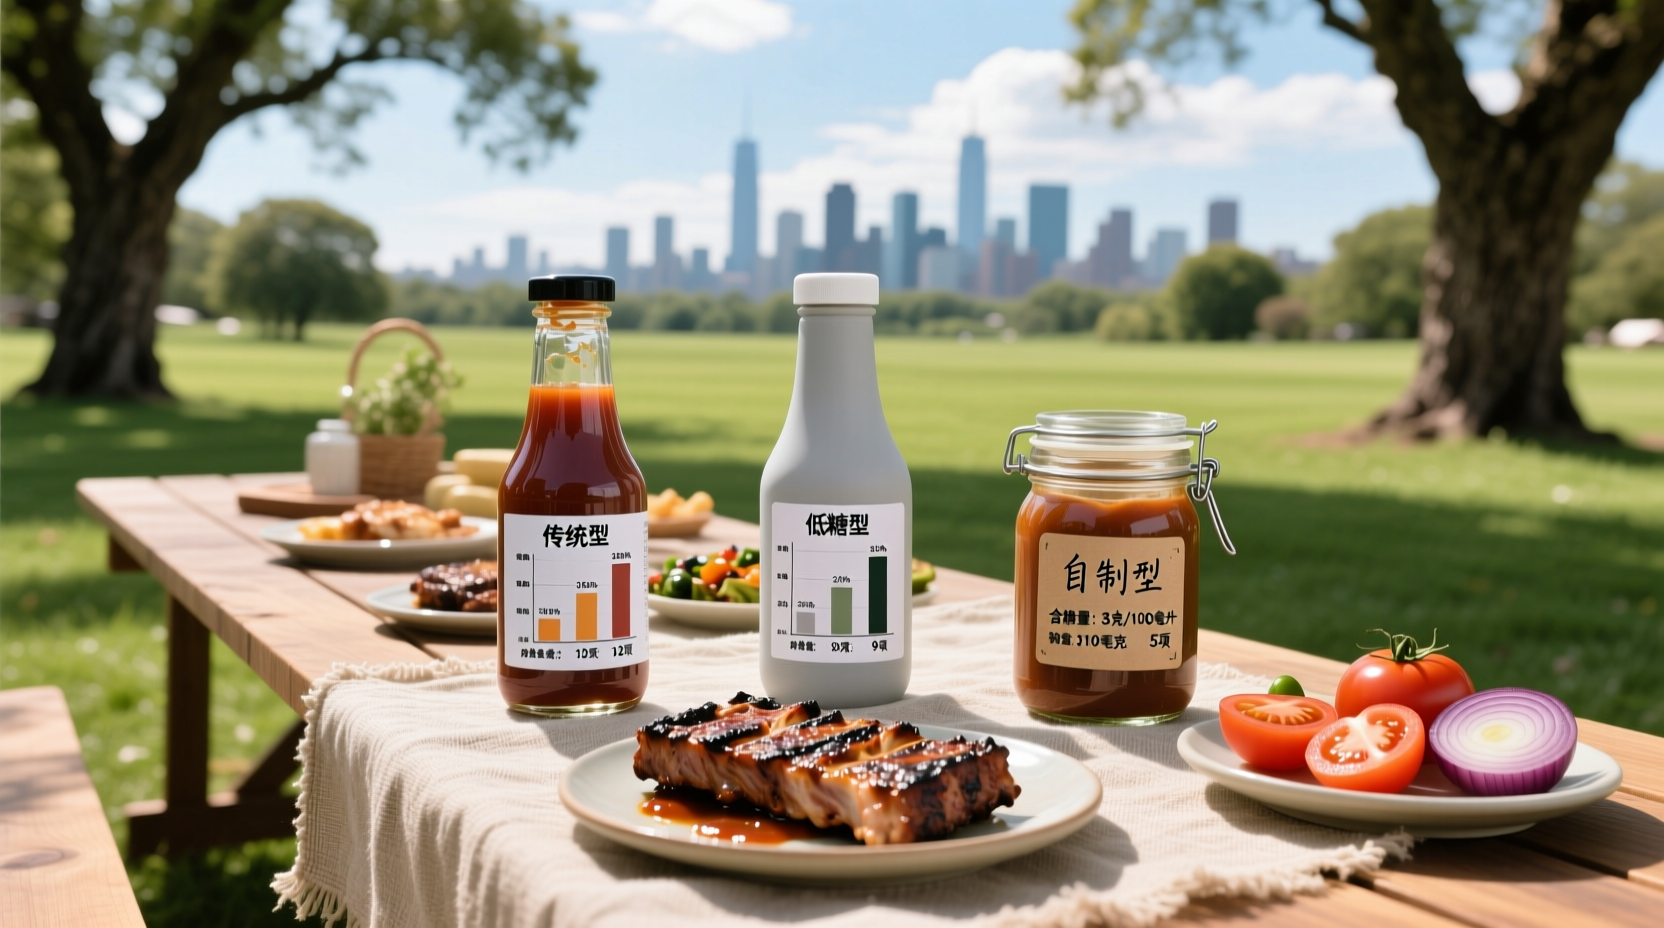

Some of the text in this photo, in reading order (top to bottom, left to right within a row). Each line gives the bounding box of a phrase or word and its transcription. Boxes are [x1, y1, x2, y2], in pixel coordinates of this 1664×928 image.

[542, 523, 609, 548] 传统型
[805, 512, 869, 536] 低糖型
[1063, 553, 1162, 596] 自制型
[1150, 632, 1171, 648] 5项
